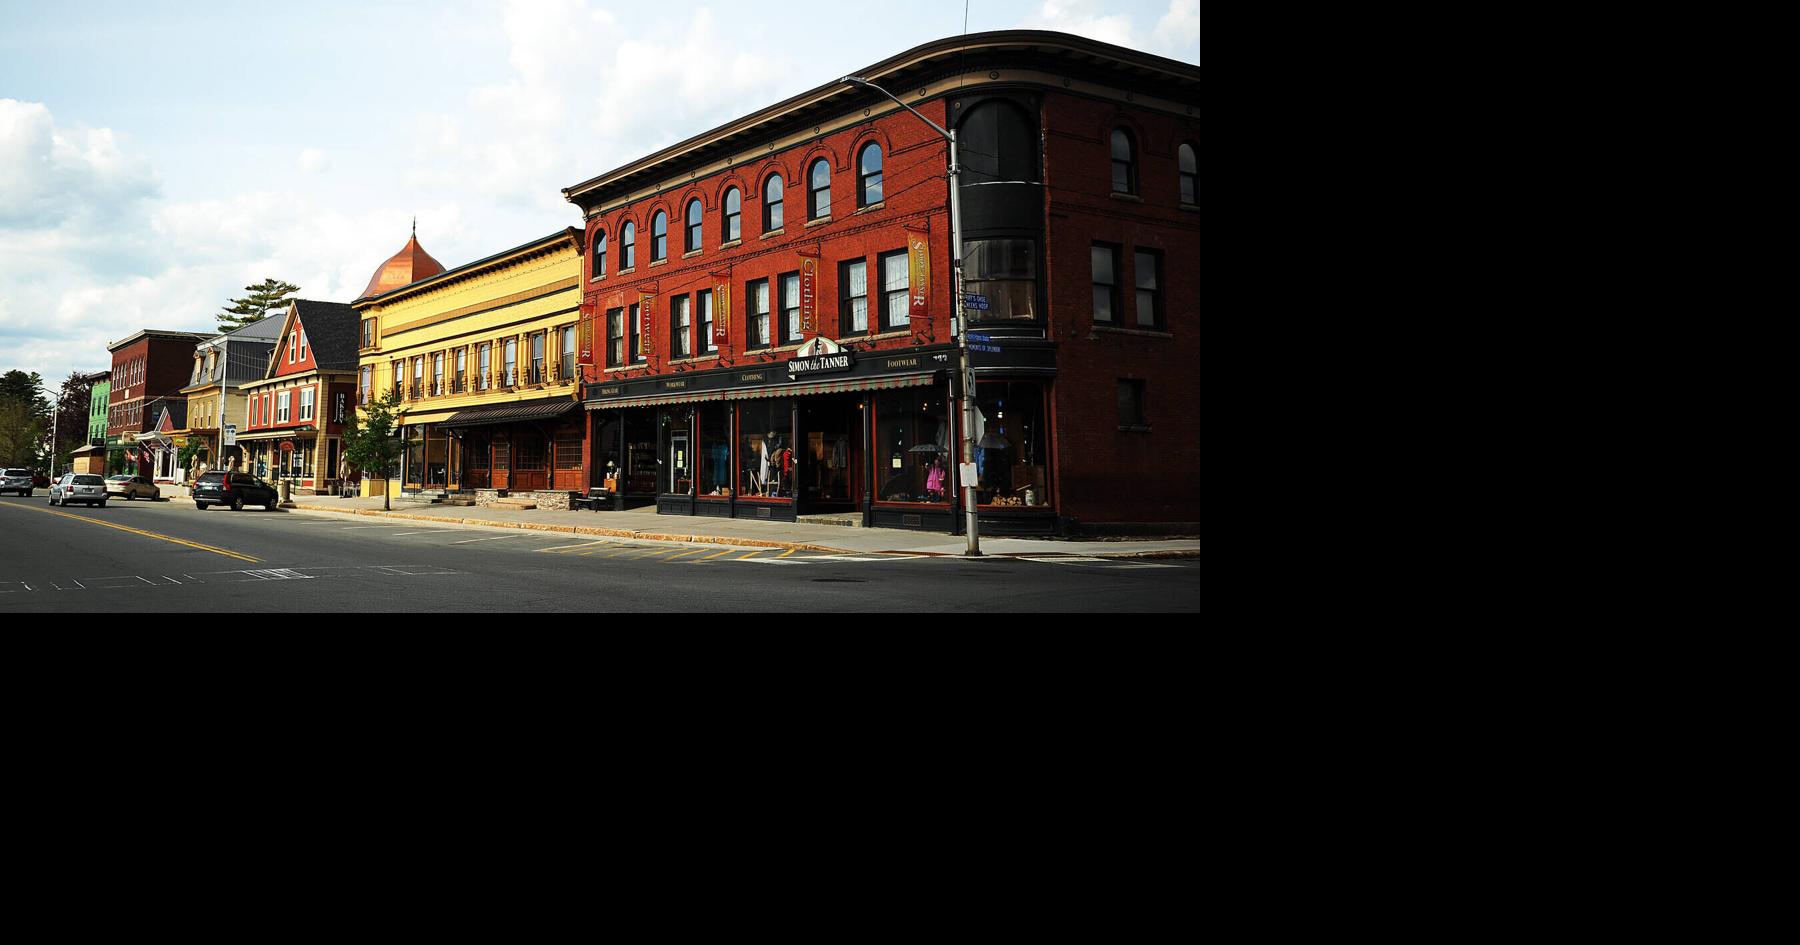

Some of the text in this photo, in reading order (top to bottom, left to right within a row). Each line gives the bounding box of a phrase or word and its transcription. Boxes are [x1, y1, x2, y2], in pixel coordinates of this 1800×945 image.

[803, 259, 814, 330] Clothing
[788, 355, 848, 372] SIMON the TANNER
[887, 358, 917, 368] FOOTWEAR
